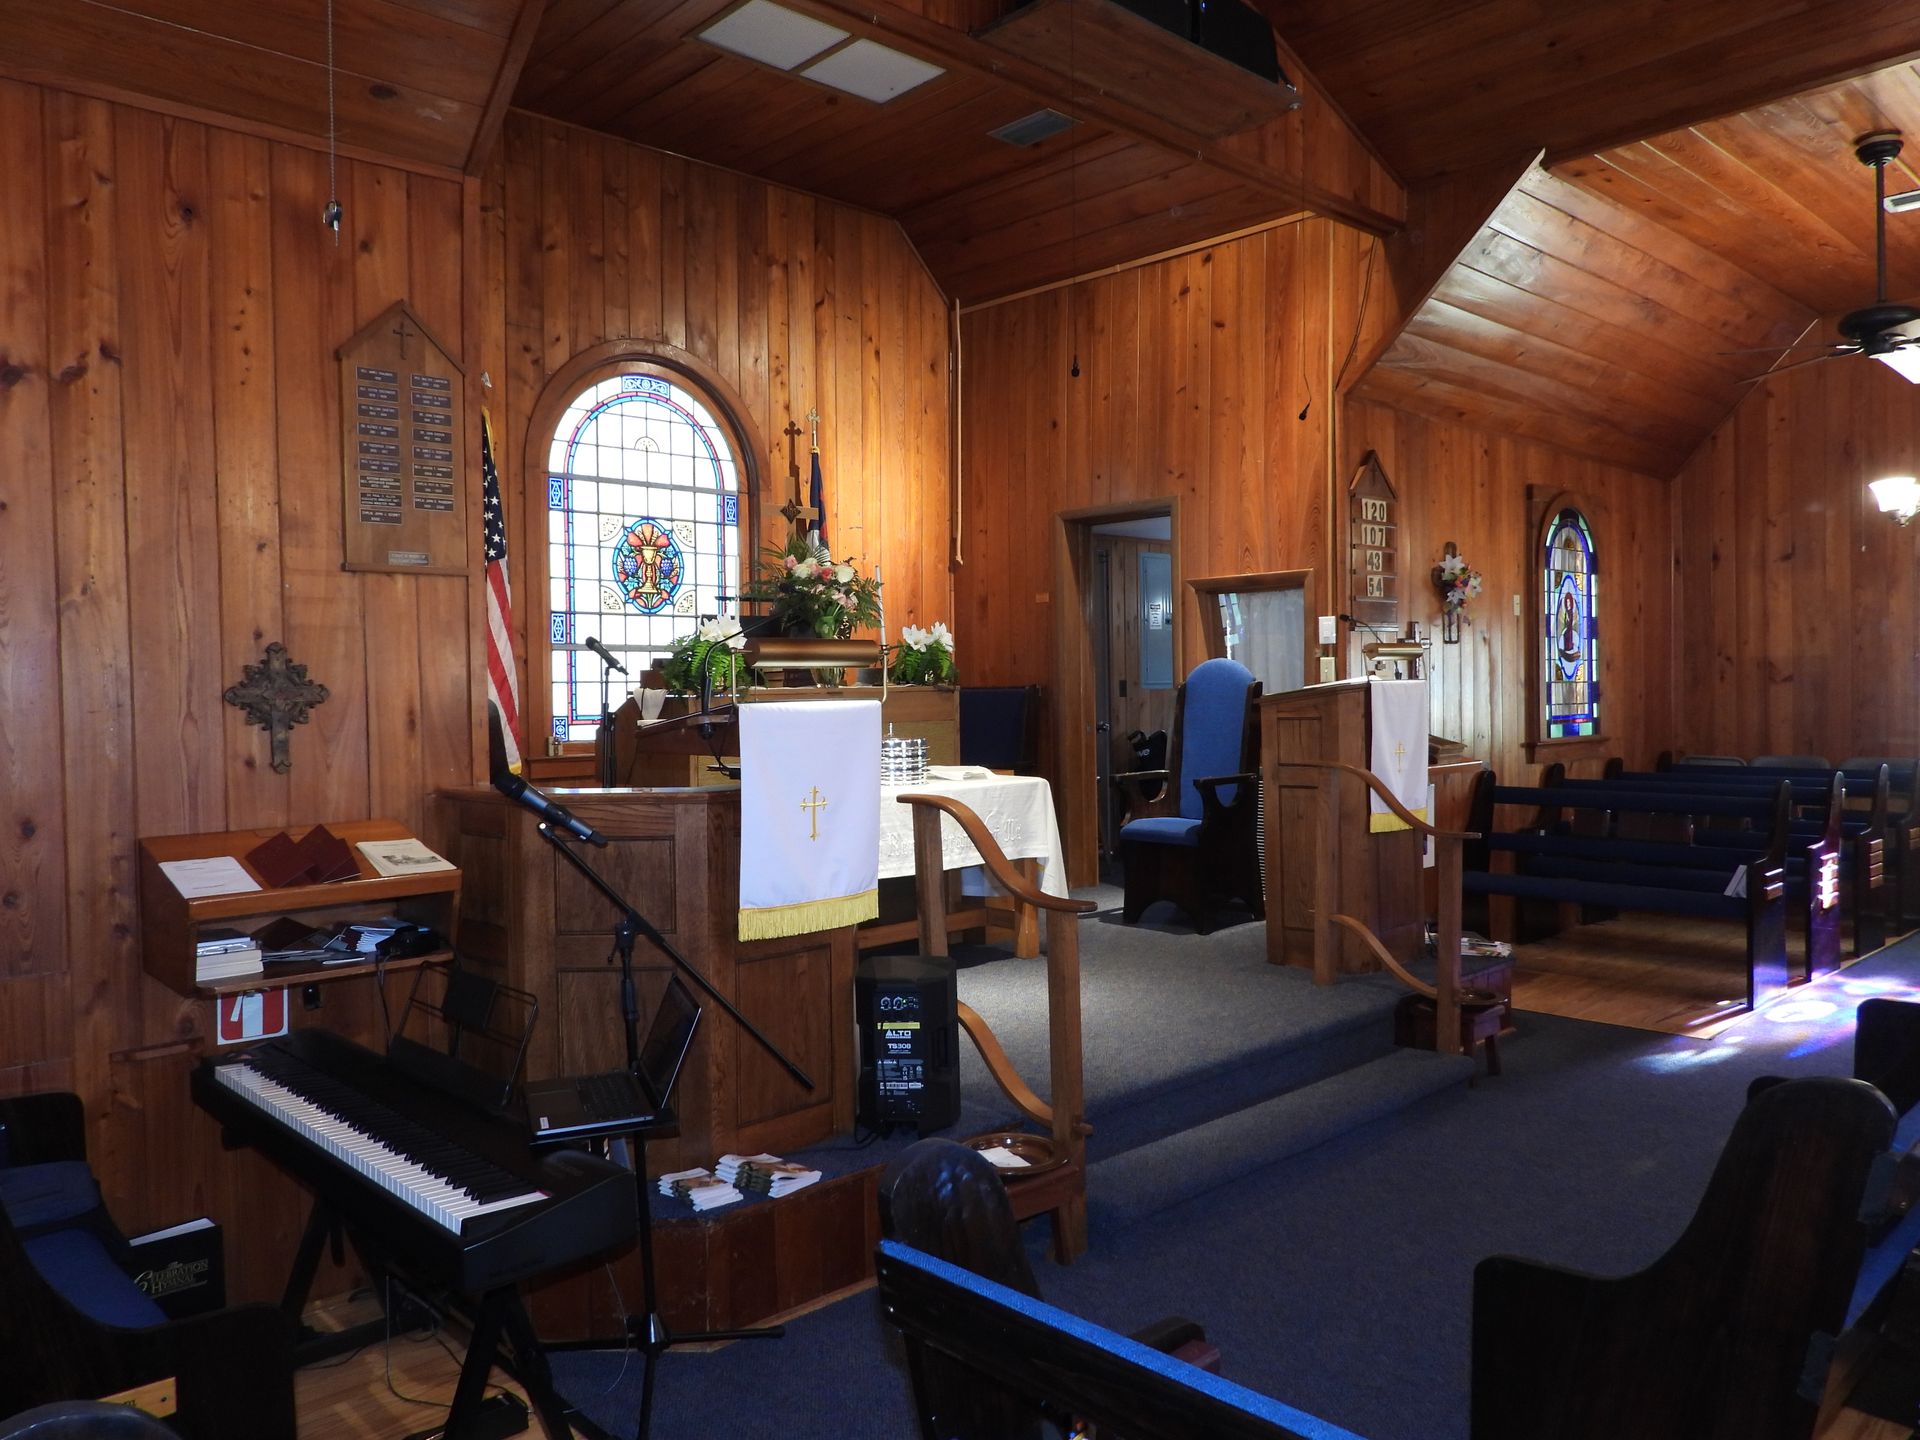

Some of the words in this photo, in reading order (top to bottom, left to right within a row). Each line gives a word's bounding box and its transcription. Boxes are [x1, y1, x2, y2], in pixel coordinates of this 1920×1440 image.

[1364, 502, 1386, 521] 120
[1363, 526, 1385, 546] 107
[1367, 551, 1382, 570] 43
[1368, 577, 1383, 597] 54
[885, 1029, 912, 1037] ALTO
